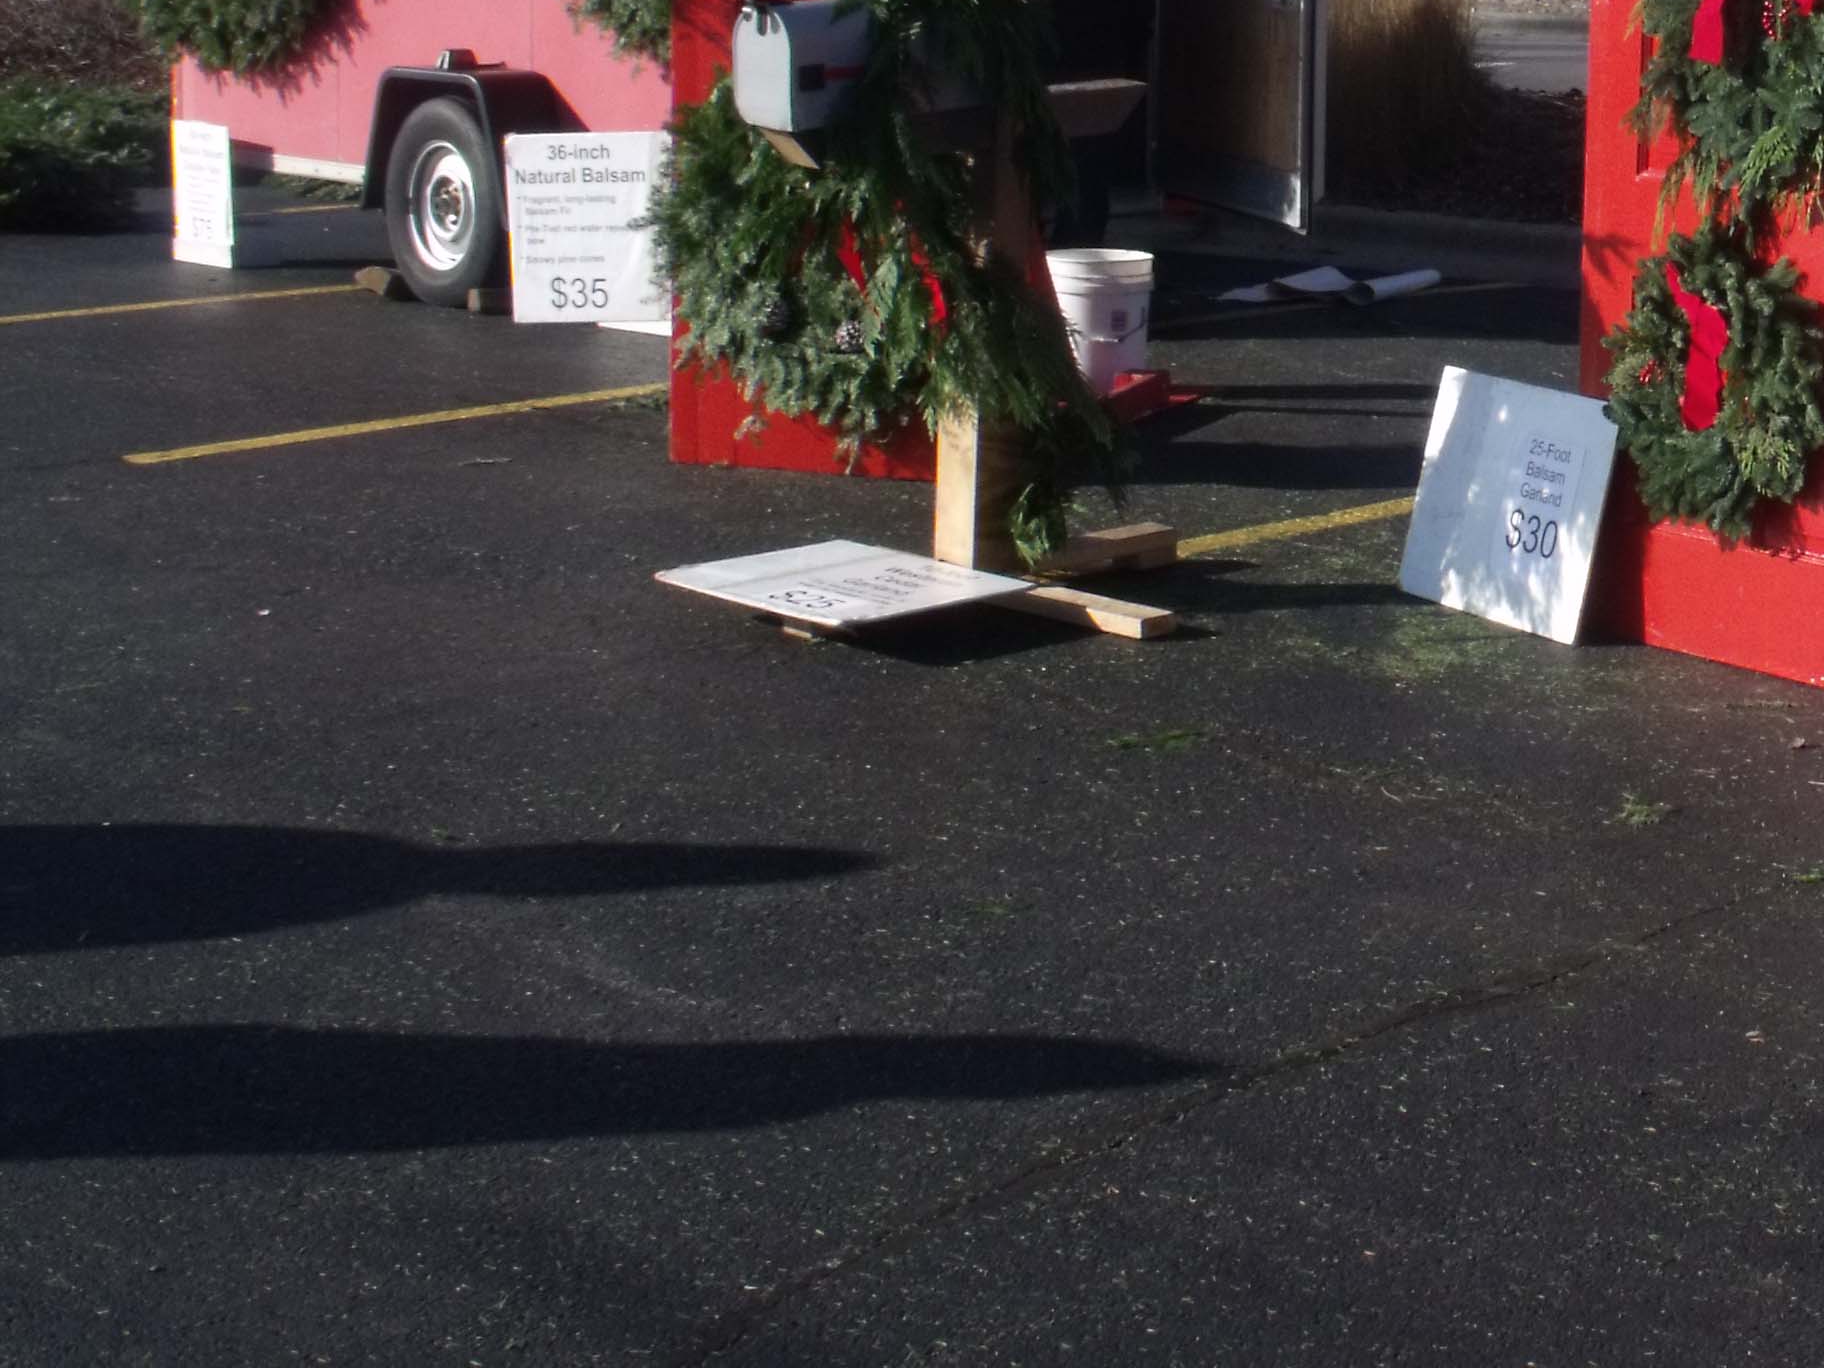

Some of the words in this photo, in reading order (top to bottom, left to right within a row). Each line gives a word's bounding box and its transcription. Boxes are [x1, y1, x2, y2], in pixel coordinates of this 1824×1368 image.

[547, 144, 611, 161] 36-inch
[515, 168, 577, 184] Natural
[582, 168, 646, 184] Balsam
[550, 277, 609, 312] $35
[1529, 438, 1573, 464] 25-Foot
[1525, 461, 1566, 484] Balsam
[1520, 483, 1563, 508] Garland
[1505, 508, 1559, 559] $30
